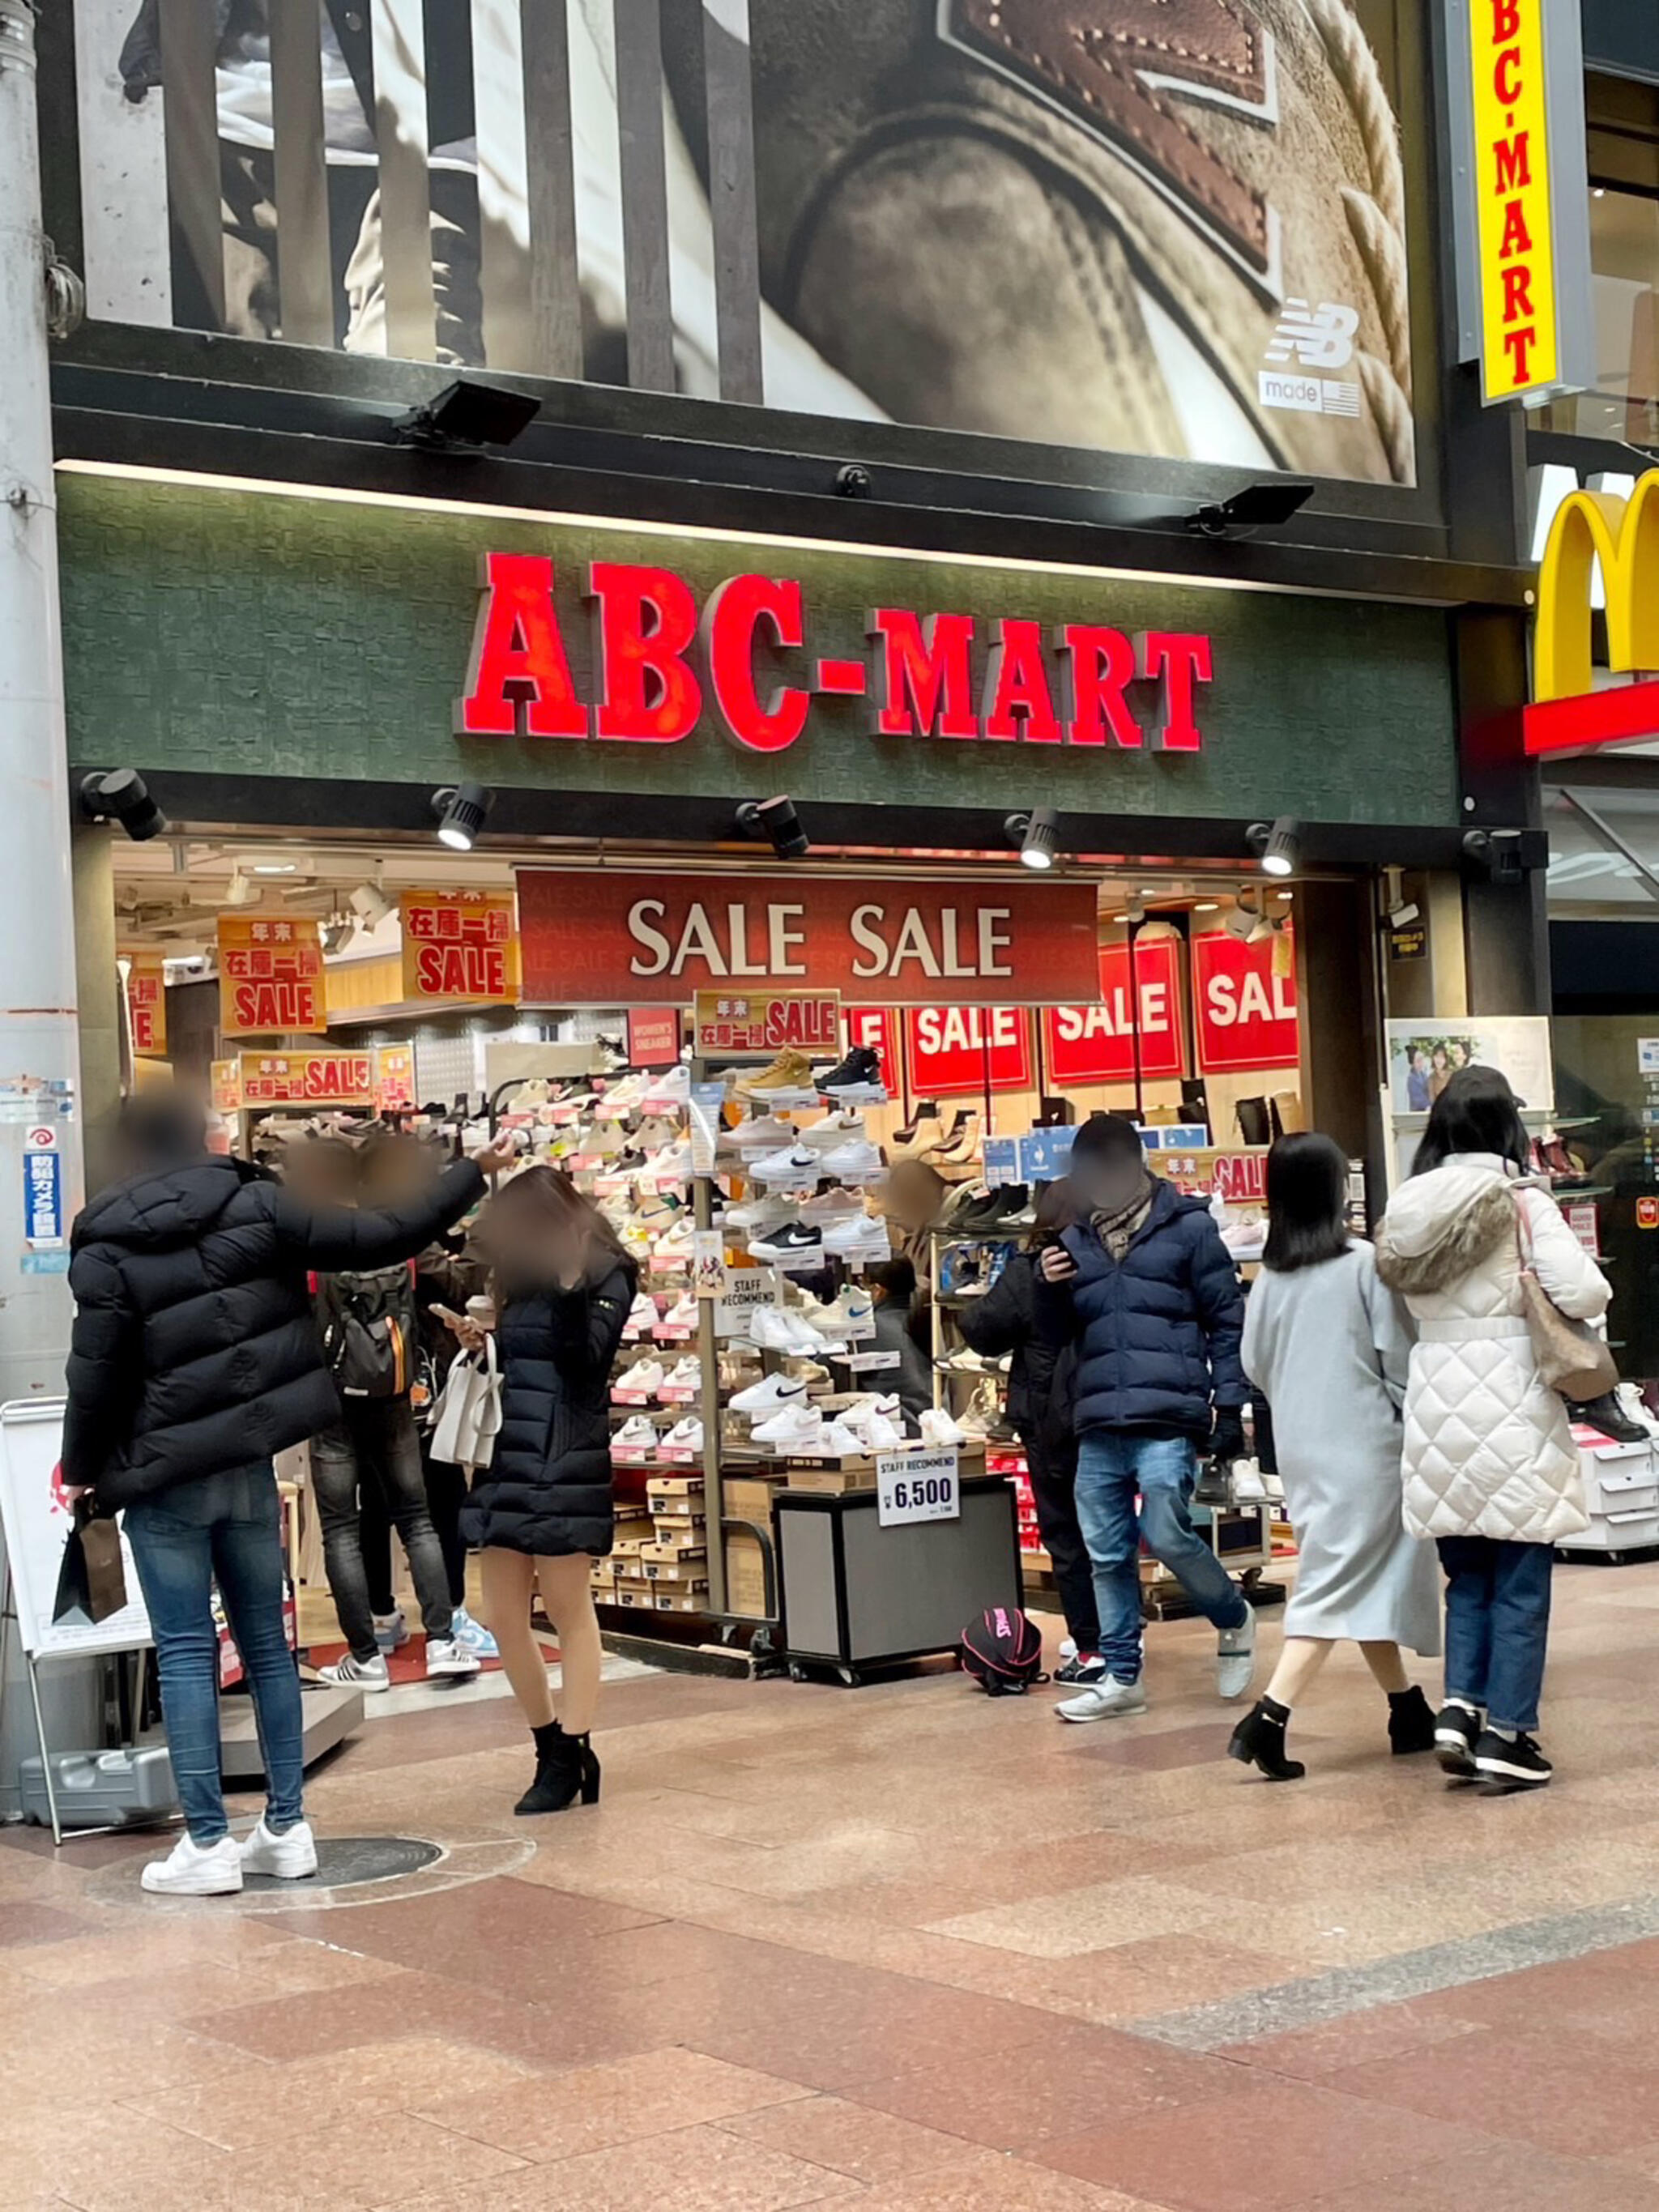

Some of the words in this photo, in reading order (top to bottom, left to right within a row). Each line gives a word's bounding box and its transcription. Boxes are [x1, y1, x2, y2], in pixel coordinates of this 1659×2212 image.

[1265, 381, 1317, 403] made
[458, 552, 1213, 752] ABC-MART
[628, 900, 806, 976] SALE
[851, 905, 1013, 978] SALE
[417, 945, 506, 997] SALE
[235, 982, 317, 1029] SALE
[717, 999, 748, 1016] 年末
[766, 999, 838, 1046] SALE
[1057, 982, 1169, 1041] SALE
[918, 1007, 1017, 1055] SALE
[305, 1057, 371, 1097] SALE
[1166, 1157, 1196, 1174] 年末
[734, 1280, 761, 1293] STAFF
[880, 1461, 905, 1474] STAFF
[906, 1456, 955, 1471] RECOMMEND
[894, 1477, 952, 1510] 6,500
